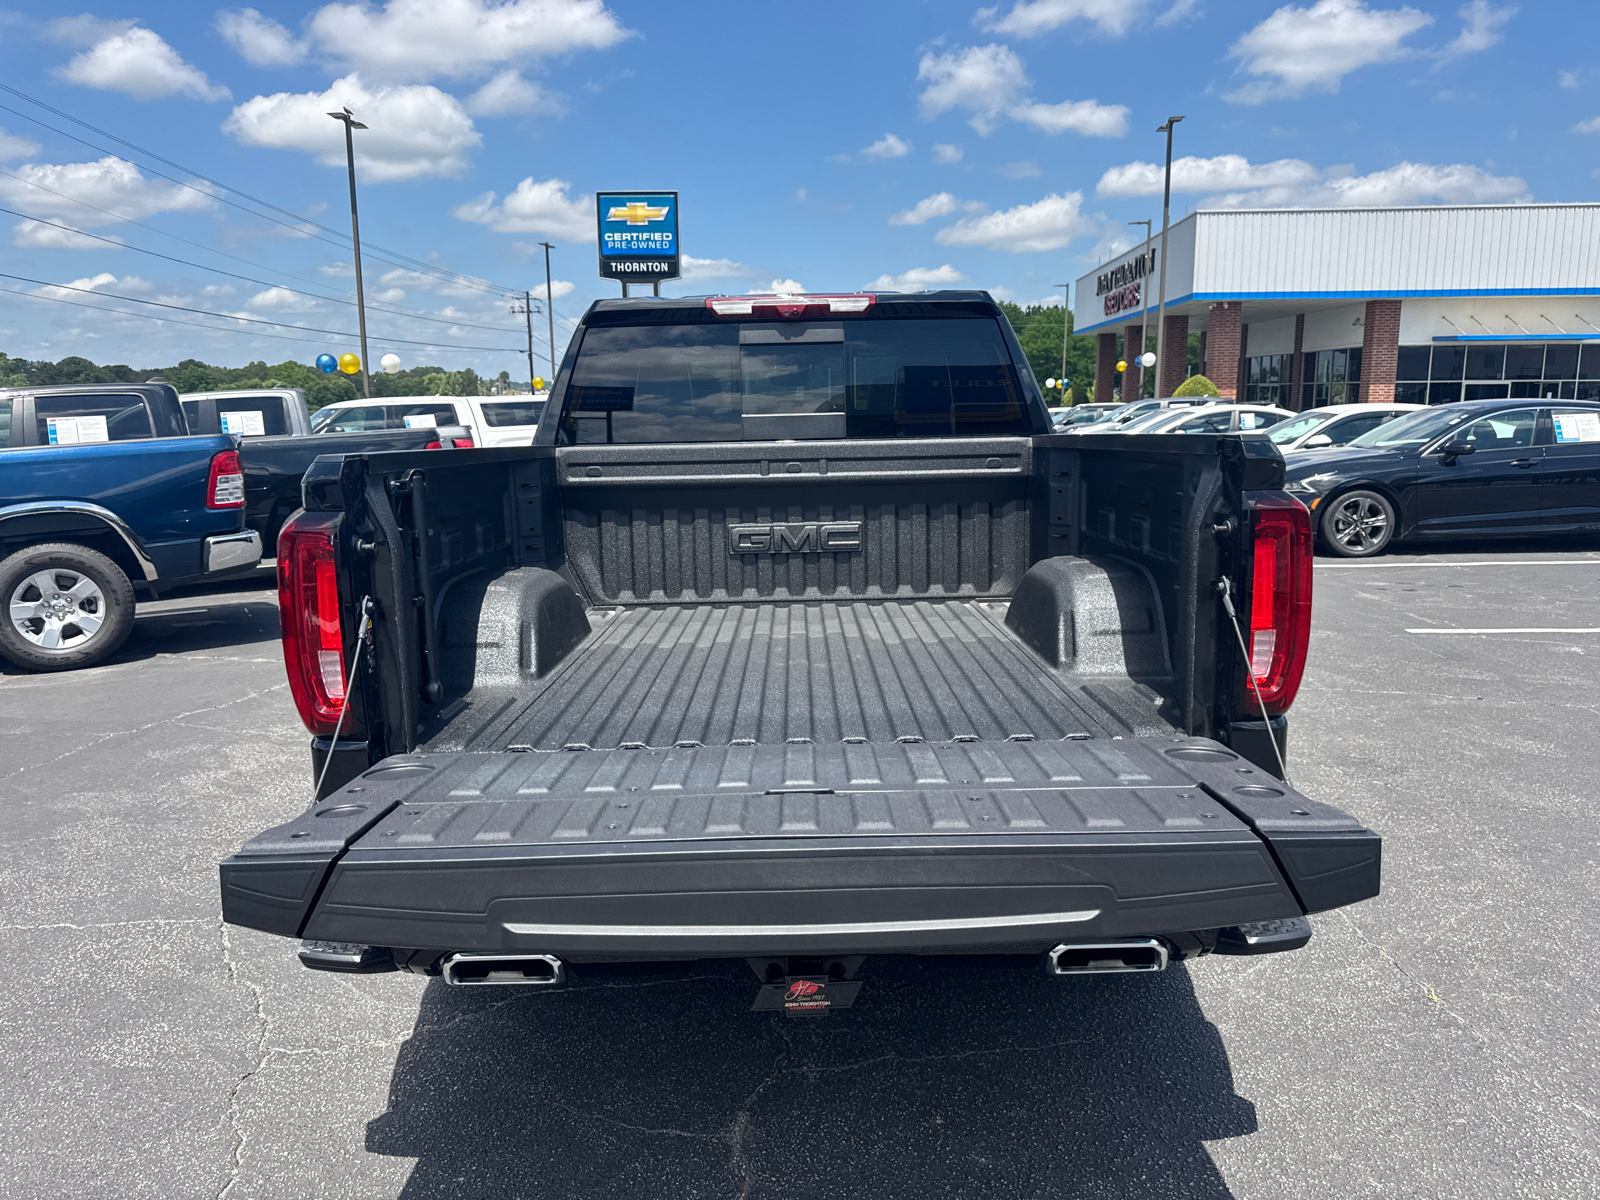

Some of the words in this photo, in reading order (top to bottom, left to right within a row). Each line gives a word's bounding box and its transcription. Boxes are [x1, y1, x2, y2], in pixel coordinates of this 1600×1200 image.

[604, 232, 673, 241] CERTIFIED
[608, 241, 669, 249] PRE-OWNED
[610, 262, 669, 272] THORNTON
[731, 524, 860, 551] GMC
